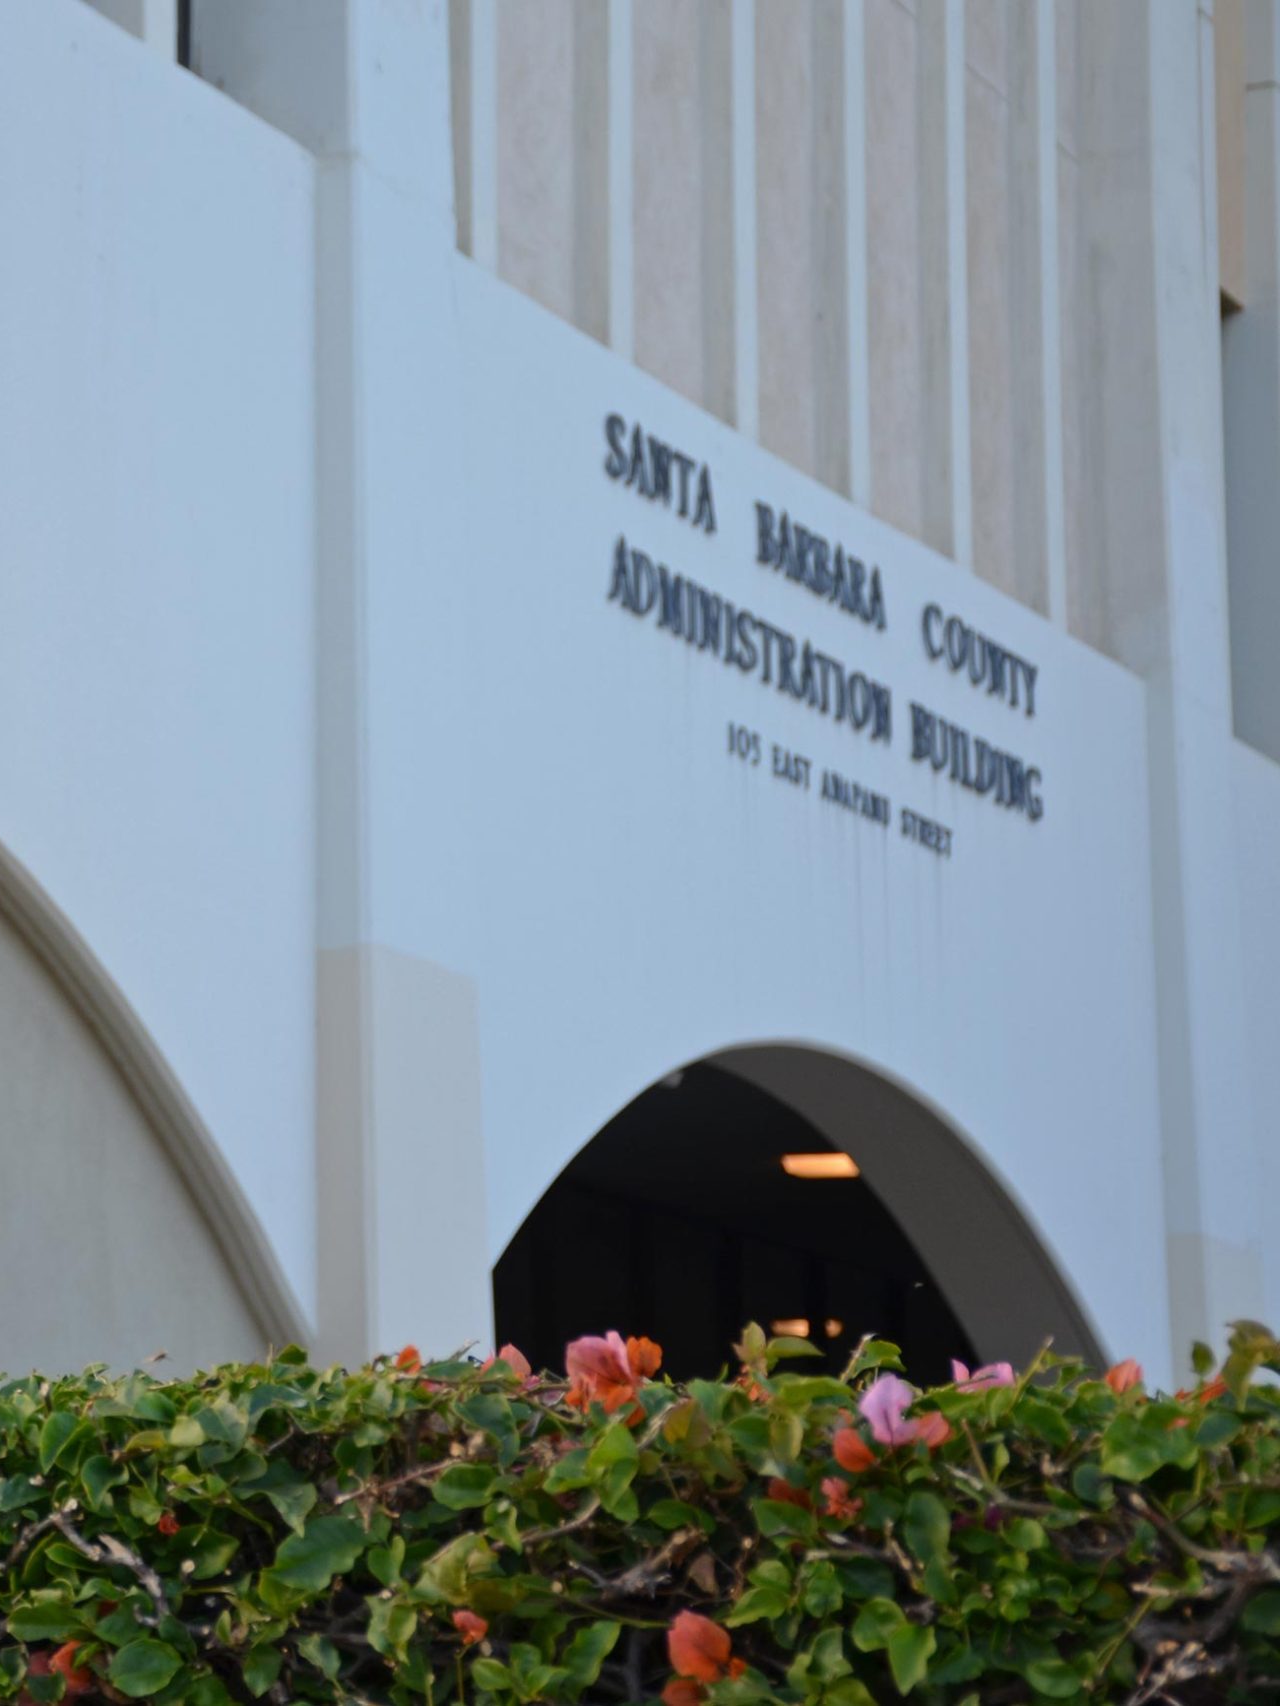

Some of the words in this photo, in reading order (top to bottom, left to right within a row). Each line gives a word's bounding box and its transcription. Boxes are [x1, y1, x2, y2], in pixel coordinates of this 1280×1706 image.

[603, 412, 717, 535] SANTA
[754, 499, 887, 632] BARBARA
[922, 602, 1038, 719] COUNTY
[608, 534, 893, 748] ADMINISTRATION
[910, 700, 1043, 823] BUILDING
[727, 721, 761, 767] 105
[771, 745, 812, 790] EAST
[900, 806, 953, 859] STREET
